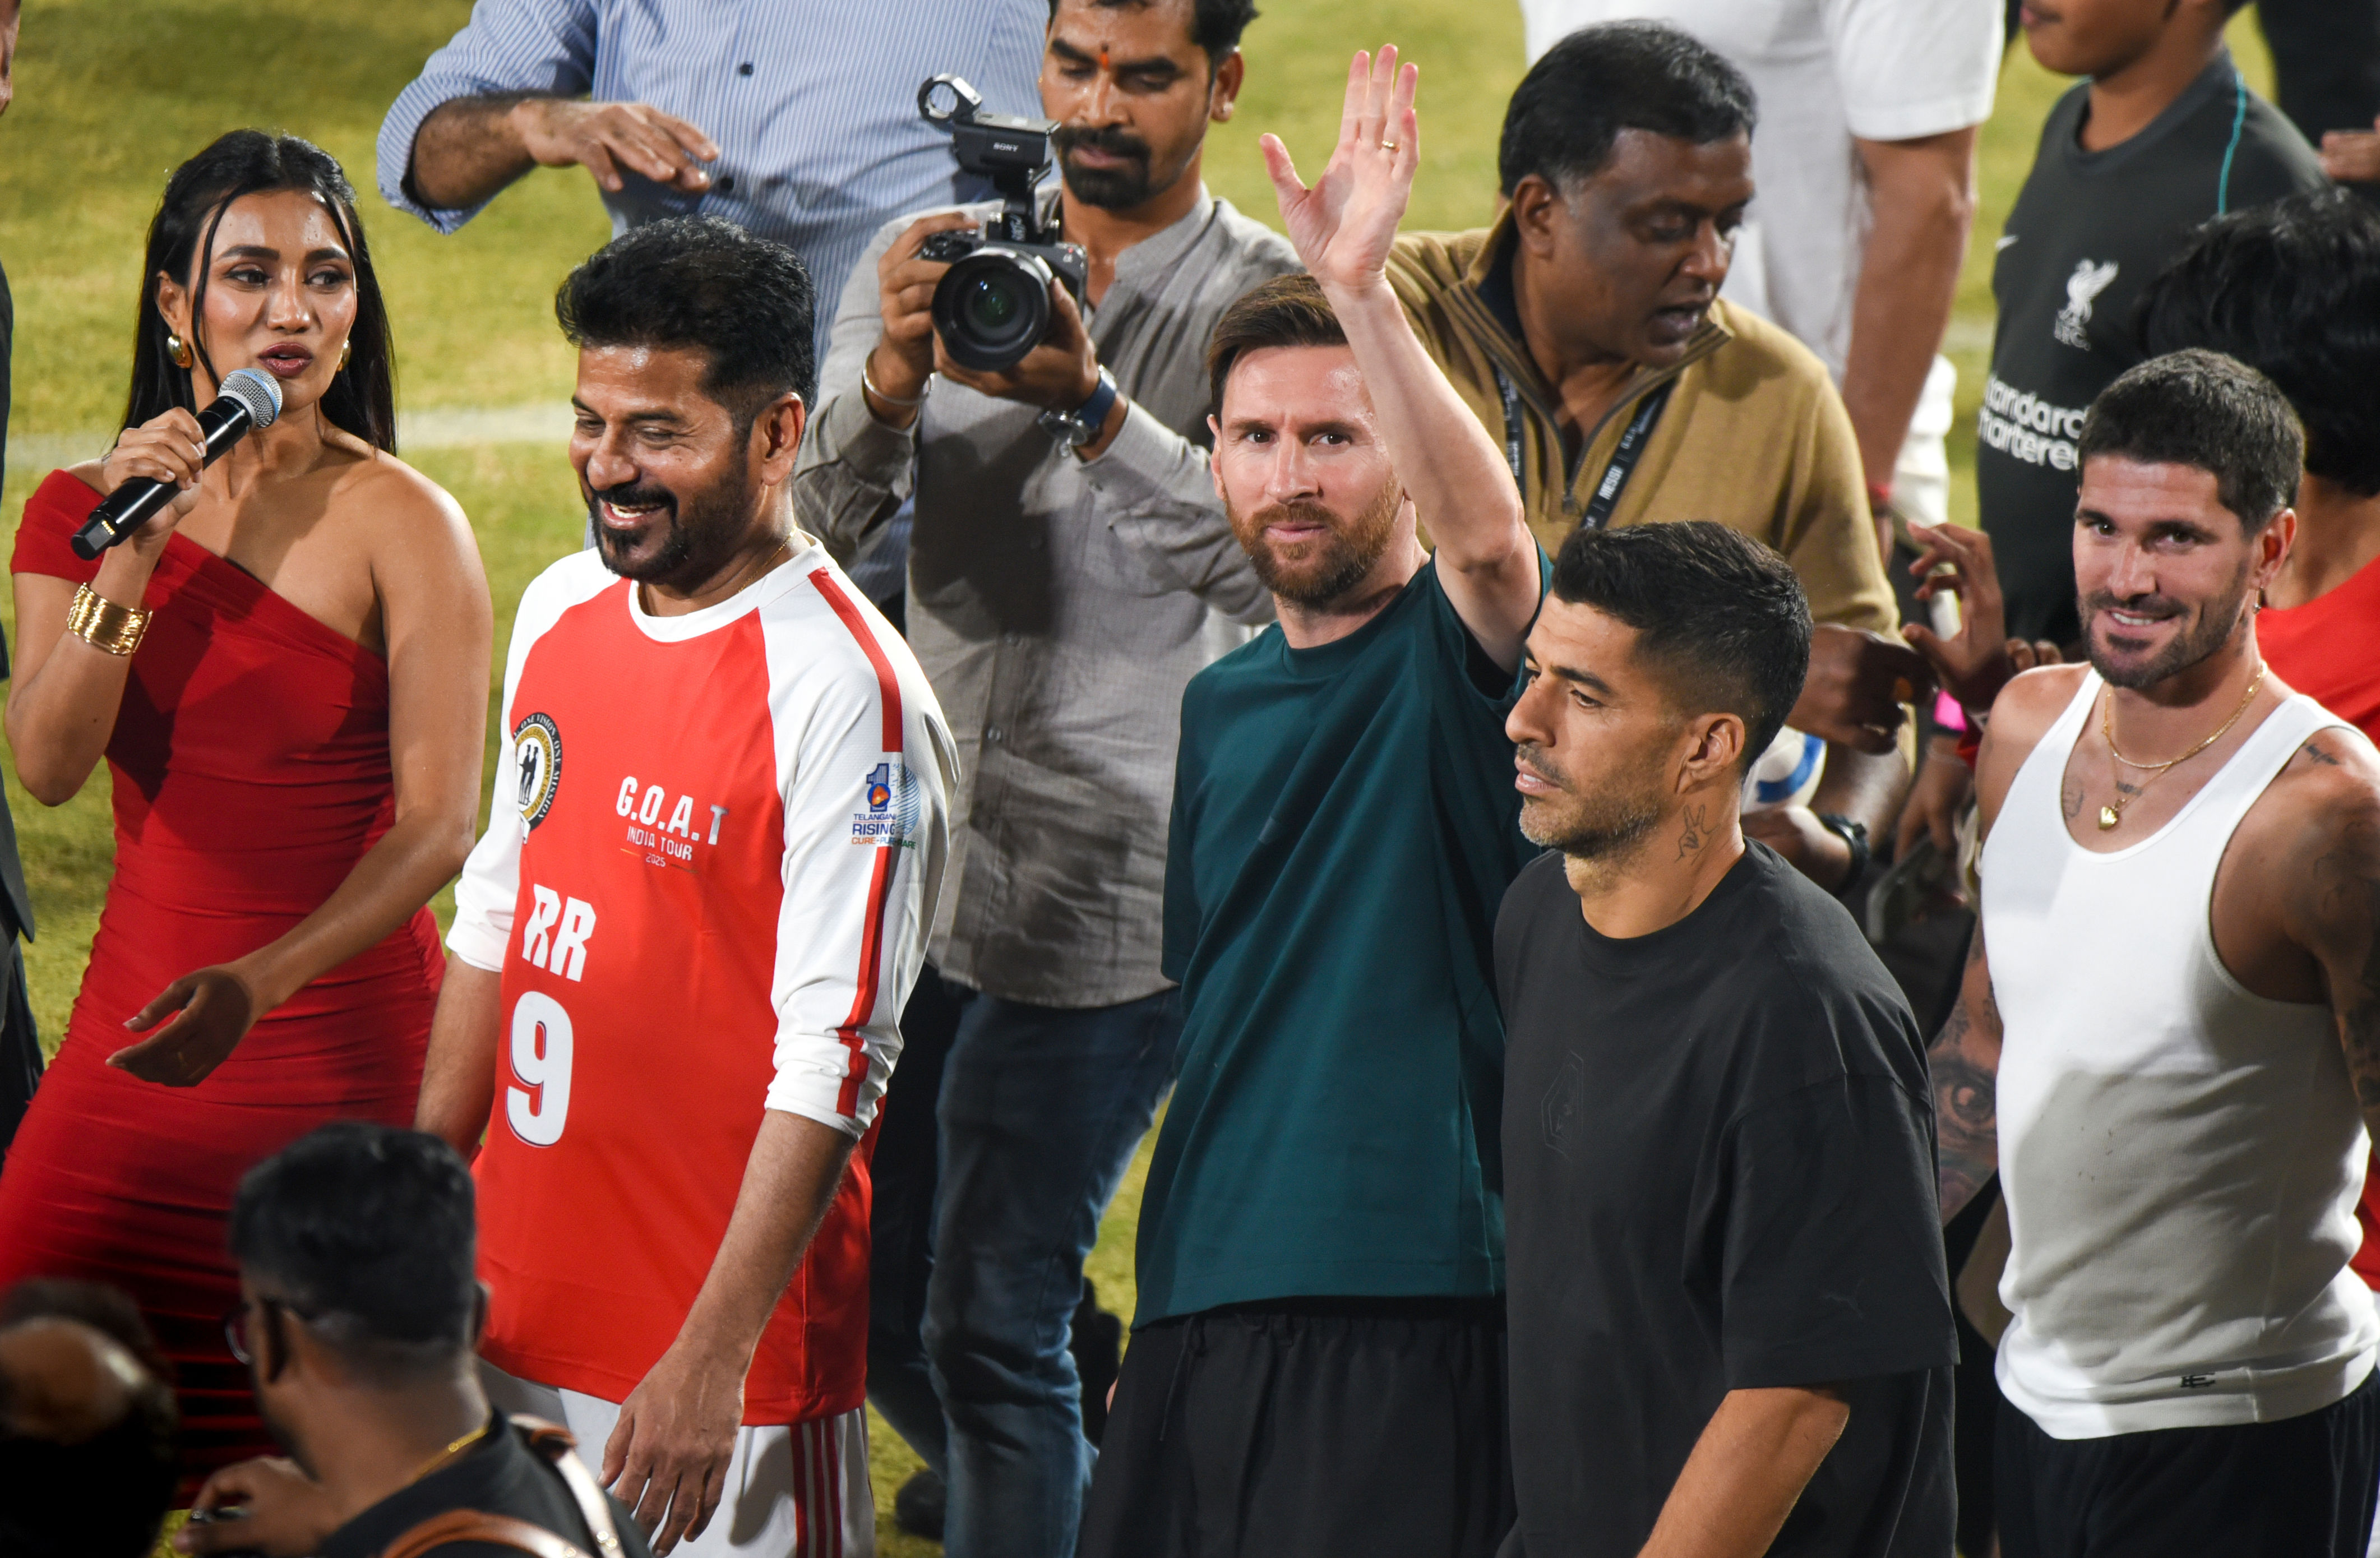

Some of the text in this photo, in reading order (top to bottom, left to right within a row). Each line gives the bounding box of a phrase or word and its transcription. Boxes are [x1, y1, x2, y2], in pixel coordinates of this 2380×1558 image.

[993, 142, 1019, 152] SONY
[853, 824, 895, 835] RISING
[627, 825, 692, 861] INDIA TOUR
[645, 853, 666, 867] 2025
[523, 884, 596, 982] RR
[506, 991, 574, 1148] 9
